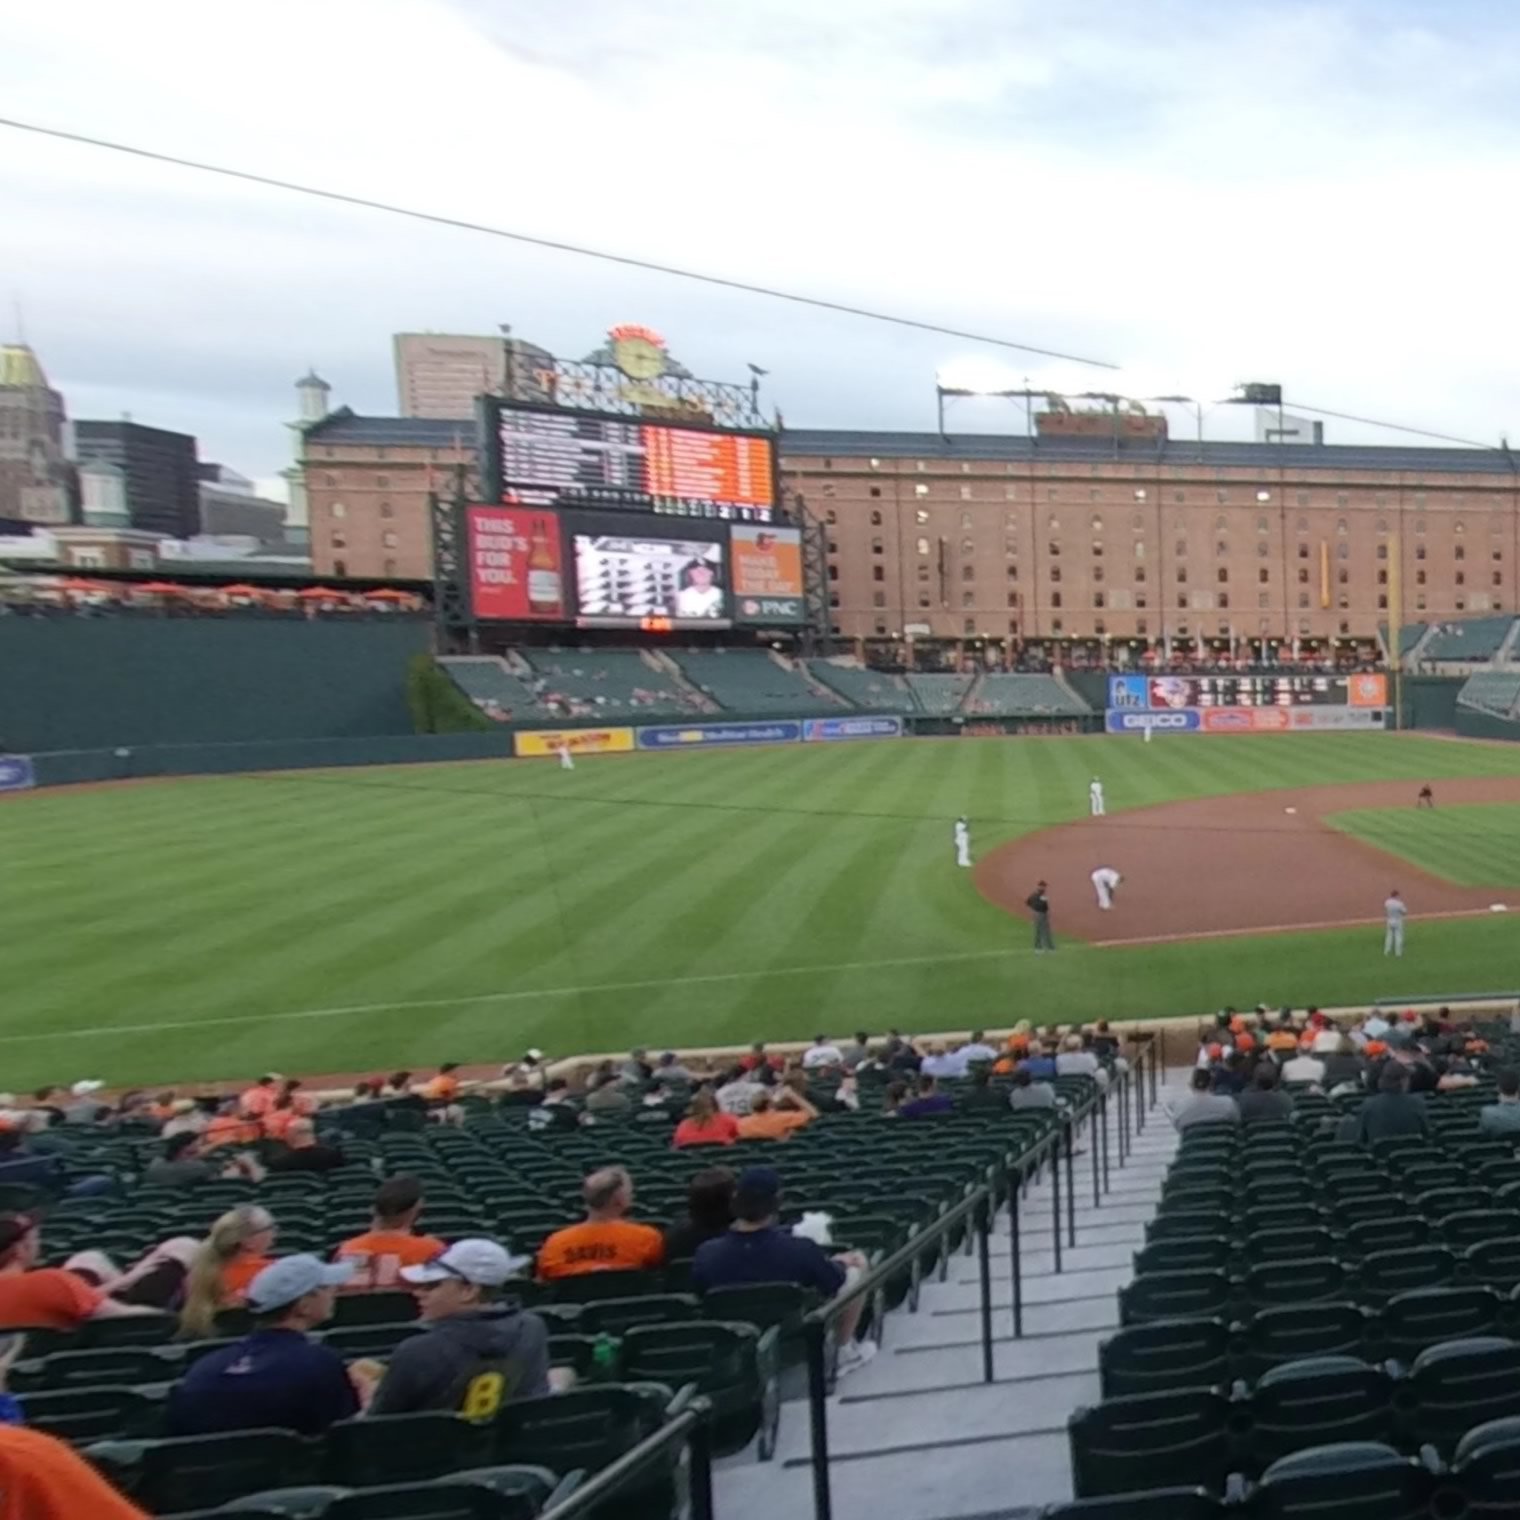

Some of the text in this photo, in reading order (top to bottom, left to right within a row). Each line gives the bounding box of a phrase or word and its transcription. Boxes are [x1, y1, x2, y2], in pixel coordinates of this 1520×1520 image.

[474, 517, 515, 534] THIS
[475, 533, 528, 552] BUD'S
[476, 551, 512, 567] FOR
[761, 601, 799, 616] PNC
[1123, 713, 1188, 728] GEICO
[563, 1243, 618, 1265] DAVIS
